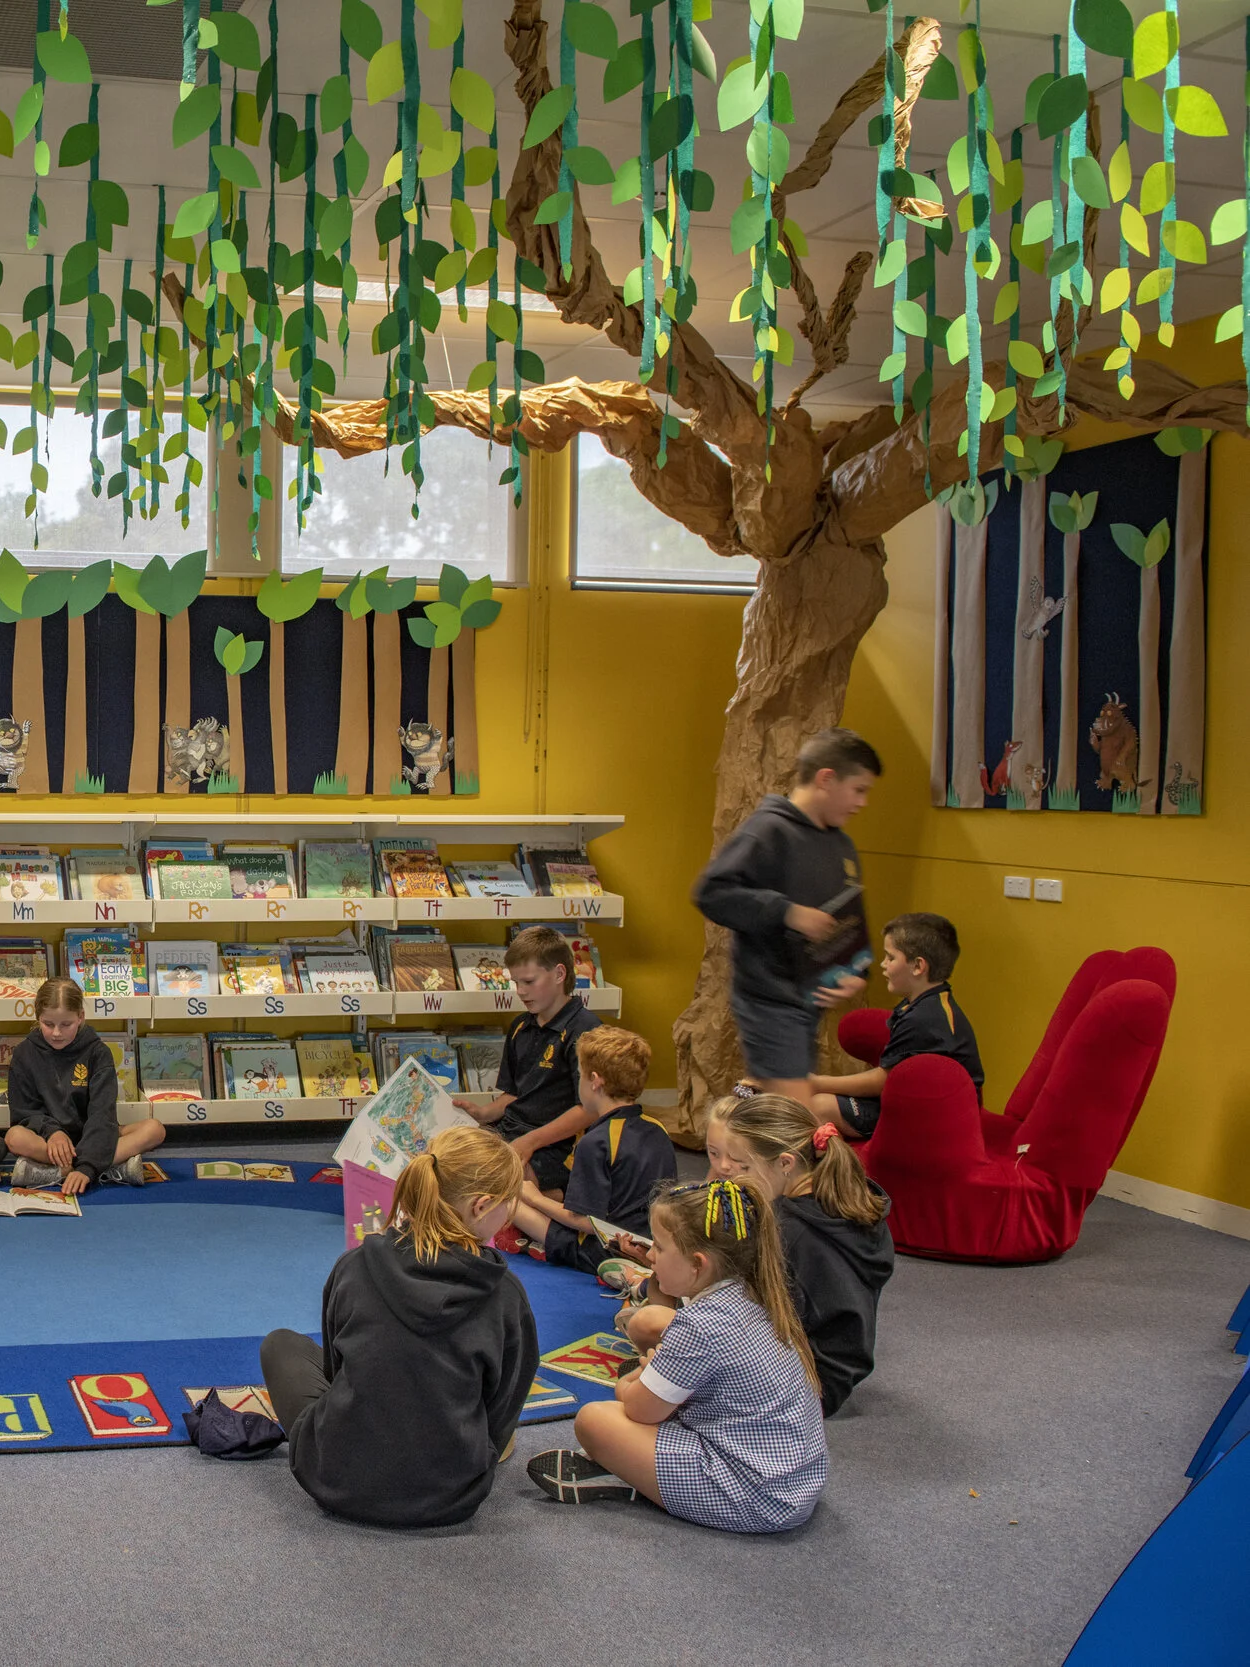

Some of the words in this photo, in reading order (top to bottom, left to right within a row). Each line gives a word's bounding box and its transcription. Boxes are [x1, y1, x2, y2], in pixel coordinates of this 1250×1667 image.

[226, 857, 248, 866] What
[249, 856, 267, 864] does
[246, 866, 273, 877] daddy
[180, 889, 217, 897] FOOTY
[13, 902, 34, 920] Mm
[95, 902, 116, 920] Nn
[189, 901, 209, 920] Rr
[267, 901, 287, 919] Rr
[343, 900, 363, 918] Rr
[424, 900, 443, 917] Tt
[493, 899, 512, 916] Tt
[562, 899, 581, 917] Uu
[583, 899, 601, 916] Vv
[155, 951, 212, 964] PEDDLES
[323, 960, 342, 968] Just
[343, 960, 359, 968] the
[100, 963, 130, 976] Early
[104, 979, 129, 992] BIG
[14, 999, 35, 1018] Oo
[94, 998, 115, 1016] Pp
[187, 997, 208, 1016] Ss
[264, 996, 284, 1014] Ss
[341, 994, 360, 1012] Ss
[423, 993, 443, 1011] Ww
[494, 992, 513, 1010] Ww
[304, 1050, 350, 1060] BICYCLE
[187, 1103, 207, 1121] Ss
[264, 1101, 284, 1119] Ss
[338, 1098, 358, 1116] Tt
